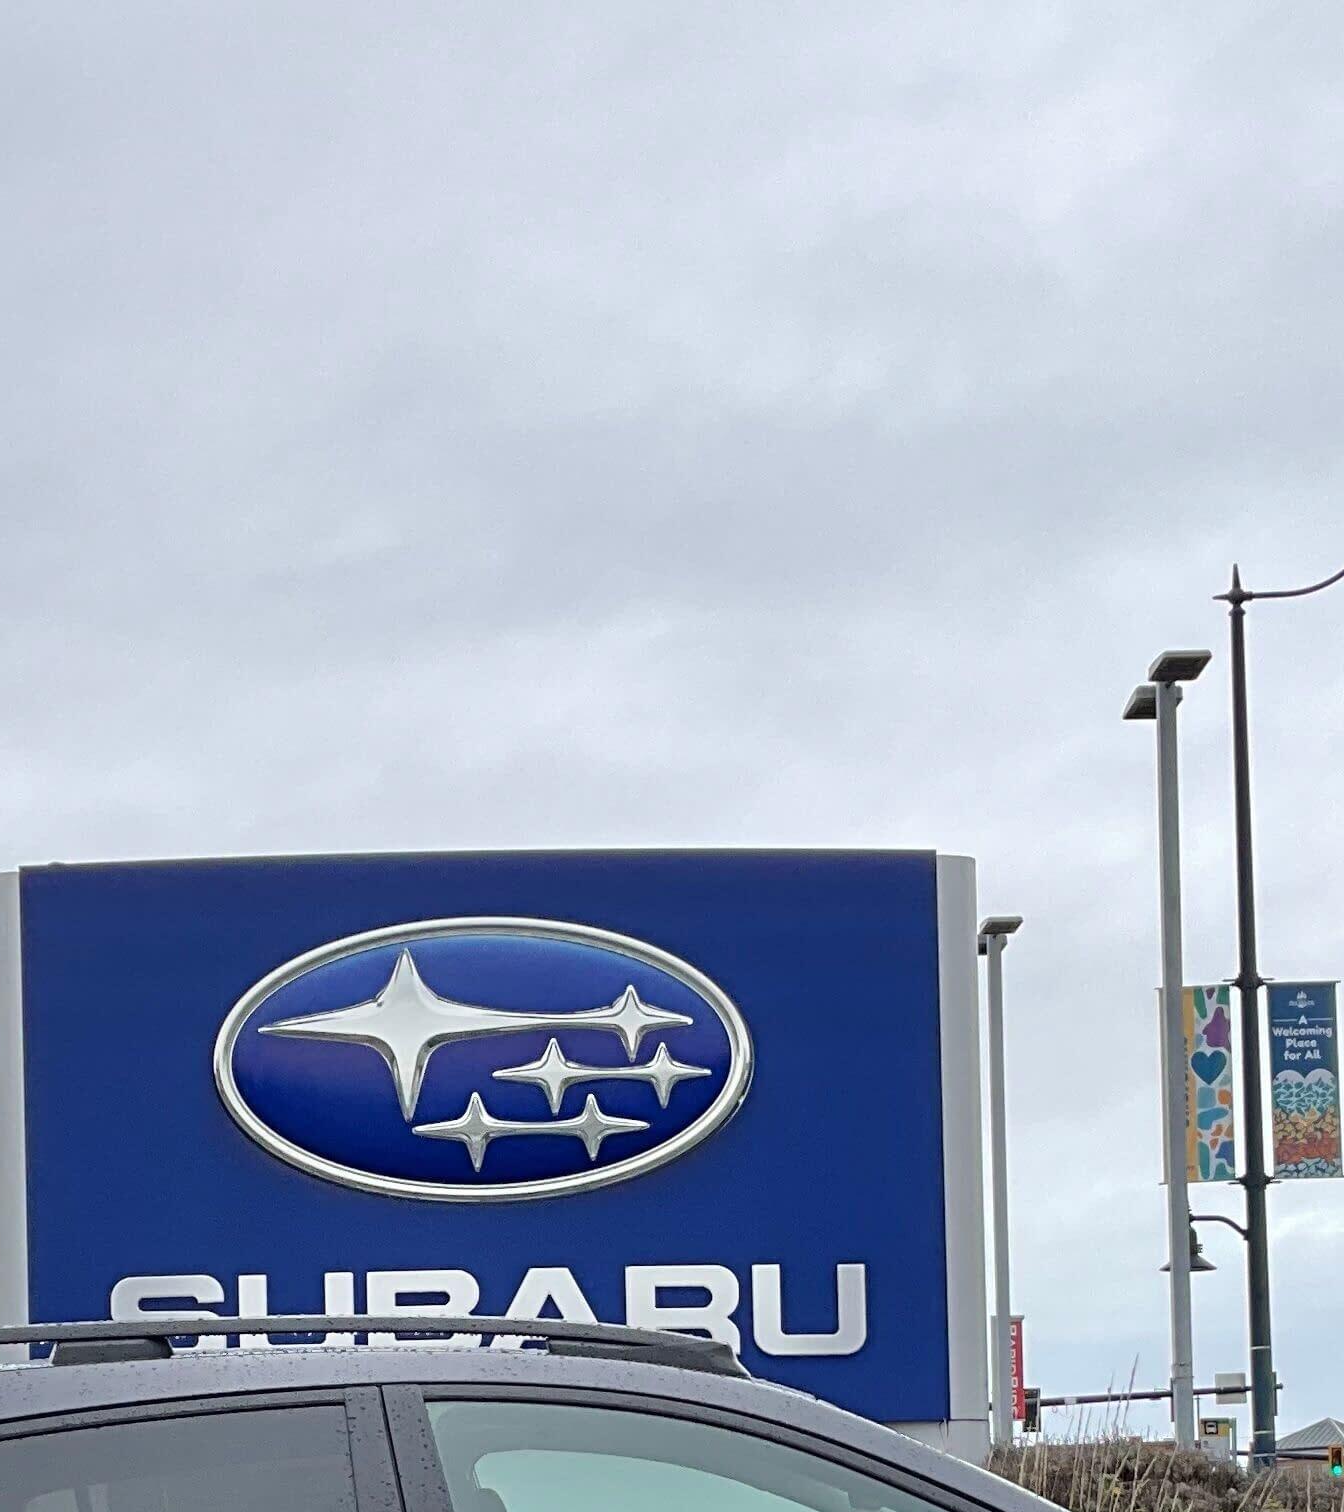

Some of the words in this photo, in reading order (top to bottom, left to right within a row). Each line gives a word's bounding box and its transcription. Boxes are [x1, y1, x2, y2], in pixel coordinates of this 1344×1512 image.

[1298, 1014, 1308, 1025] A
[1272, 1026, 1332, 1038] Welcoming
[1286, 1038, 1317, 1048] Place
[1284, 1050, 1302, 1061] for
[1304, 1049, 1321, 1059] All
[109, 1263, 867, 1358] SUBARU
